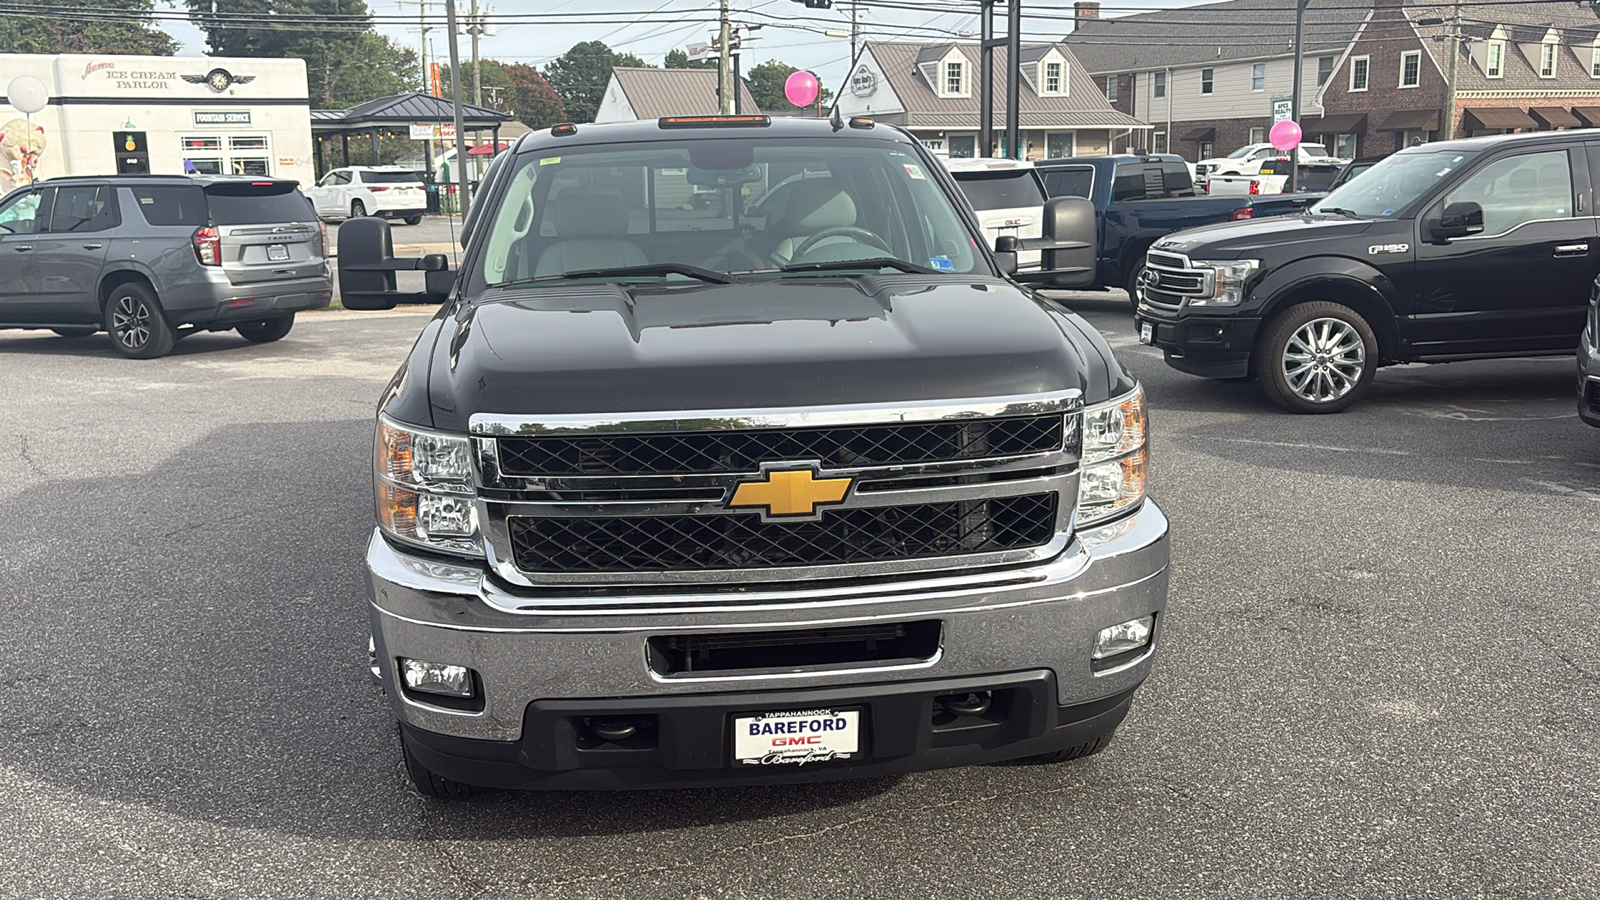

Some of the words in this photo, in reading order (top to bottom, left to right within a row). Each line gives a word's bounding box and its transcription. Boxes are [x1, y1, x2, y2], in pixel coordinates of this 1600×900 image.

[106, 71, 128, 79] ICE
[130, 71, 177, 80] CREAM
[116, 80, 169, 89] PARLOR
[226, 112, 250, 123] SERVICE
[764, 708, 832, 718] TAPPAHANNOCK
[749, 717, 847, 736] BAREFORD
[771, 735, 822, 747] GMC
[761, 750, 835, 766] Bareford
